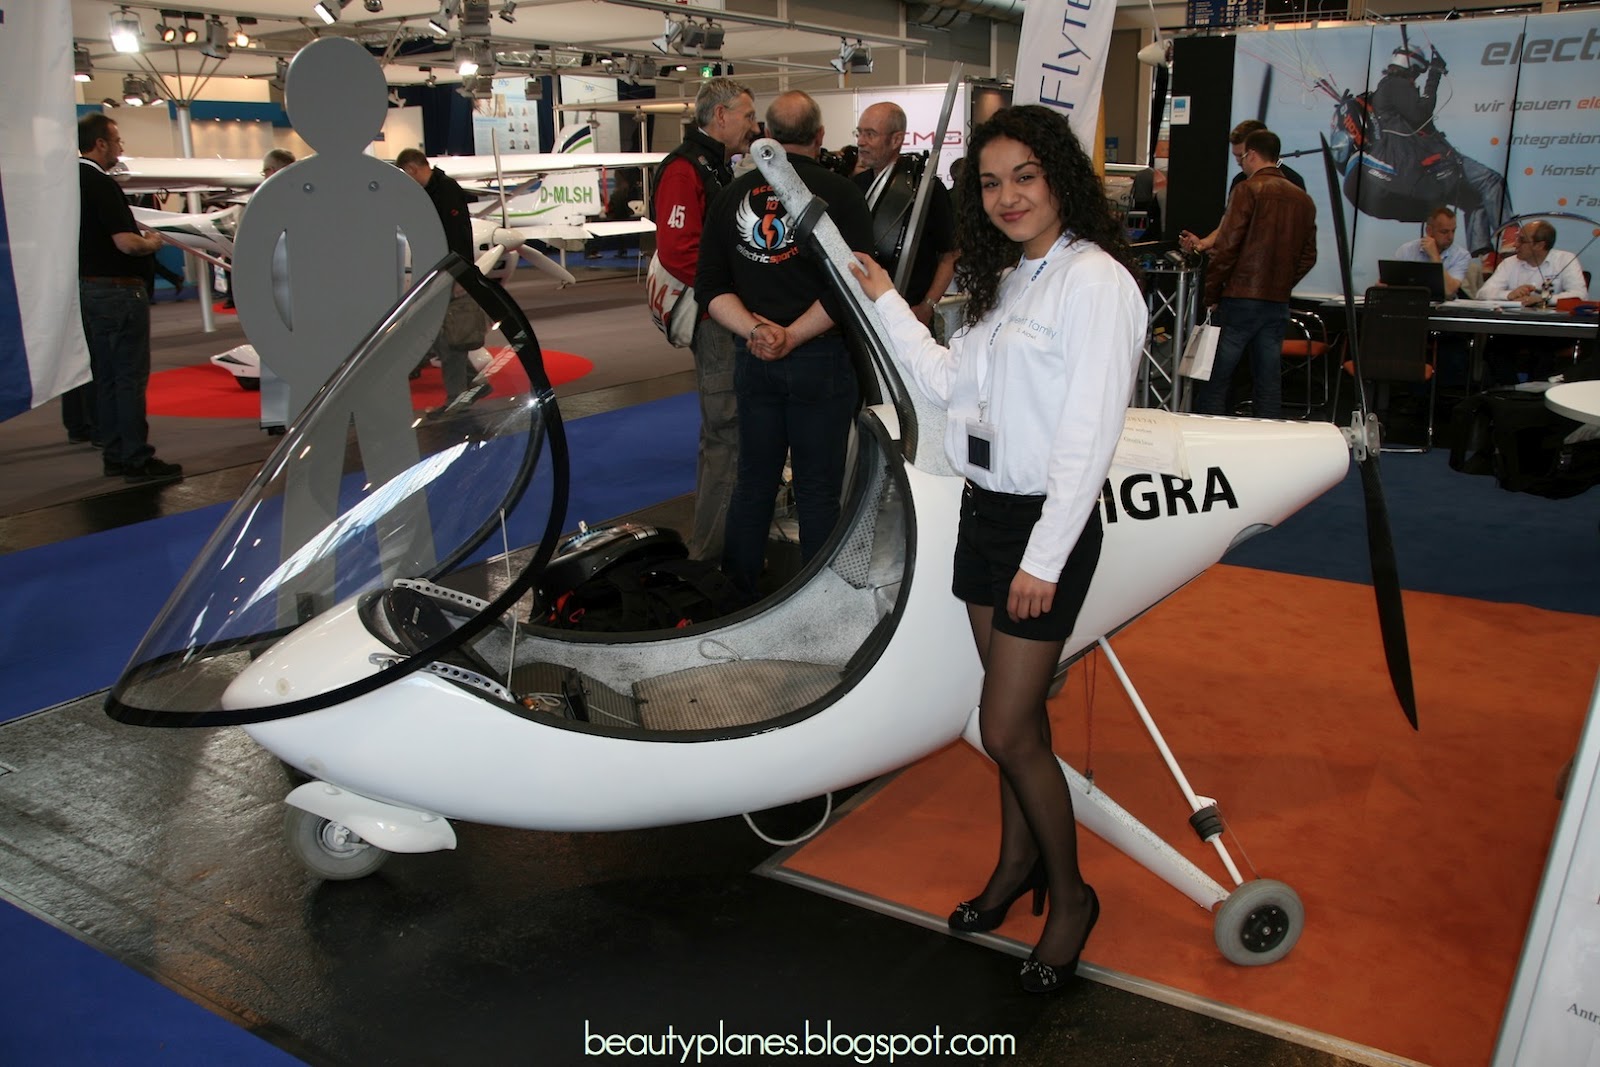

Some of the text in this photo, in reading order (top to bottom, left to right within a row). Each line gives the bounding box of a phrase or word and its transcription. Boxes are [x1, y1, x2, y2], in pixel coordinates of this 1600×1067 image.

[1474, 100, 1505, 112] wir
[541, 186, 592, 203] D-MLSH
[667, 205, 685, 229] 45
